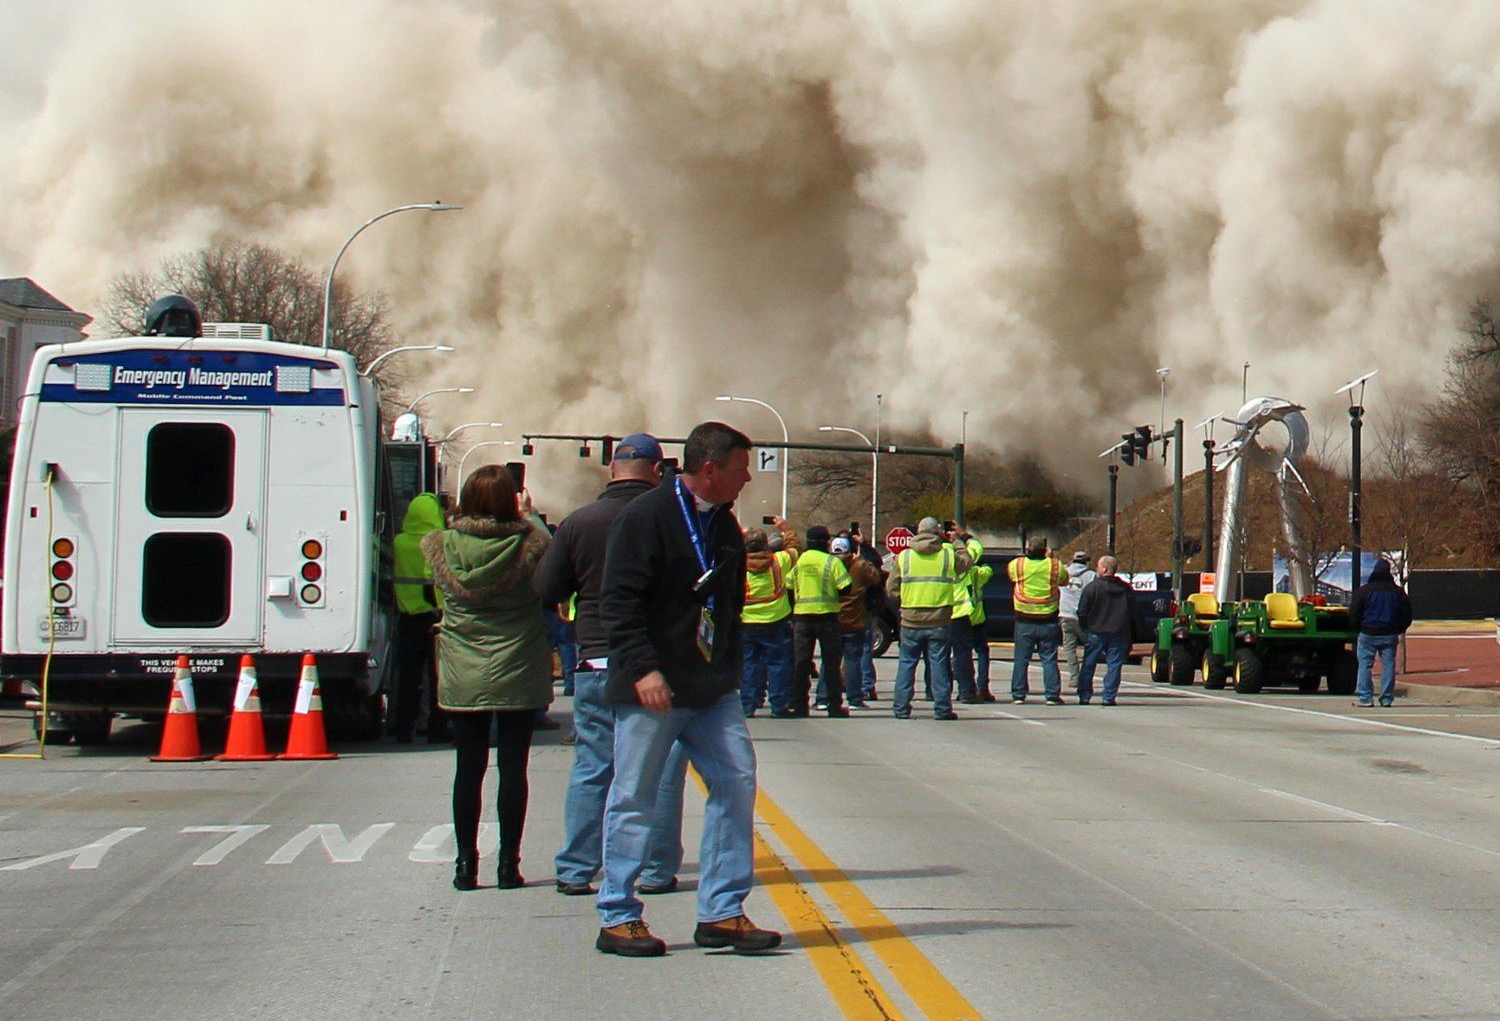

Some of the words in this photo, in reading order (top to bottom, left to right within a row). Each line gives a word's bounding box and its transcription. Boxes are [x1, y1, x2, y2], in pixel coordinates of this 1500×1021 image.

[114, 366, 186, 388] Emergency
[188, 367, 272, 389] Management
[1133, 581, 1153, 589] ENT
